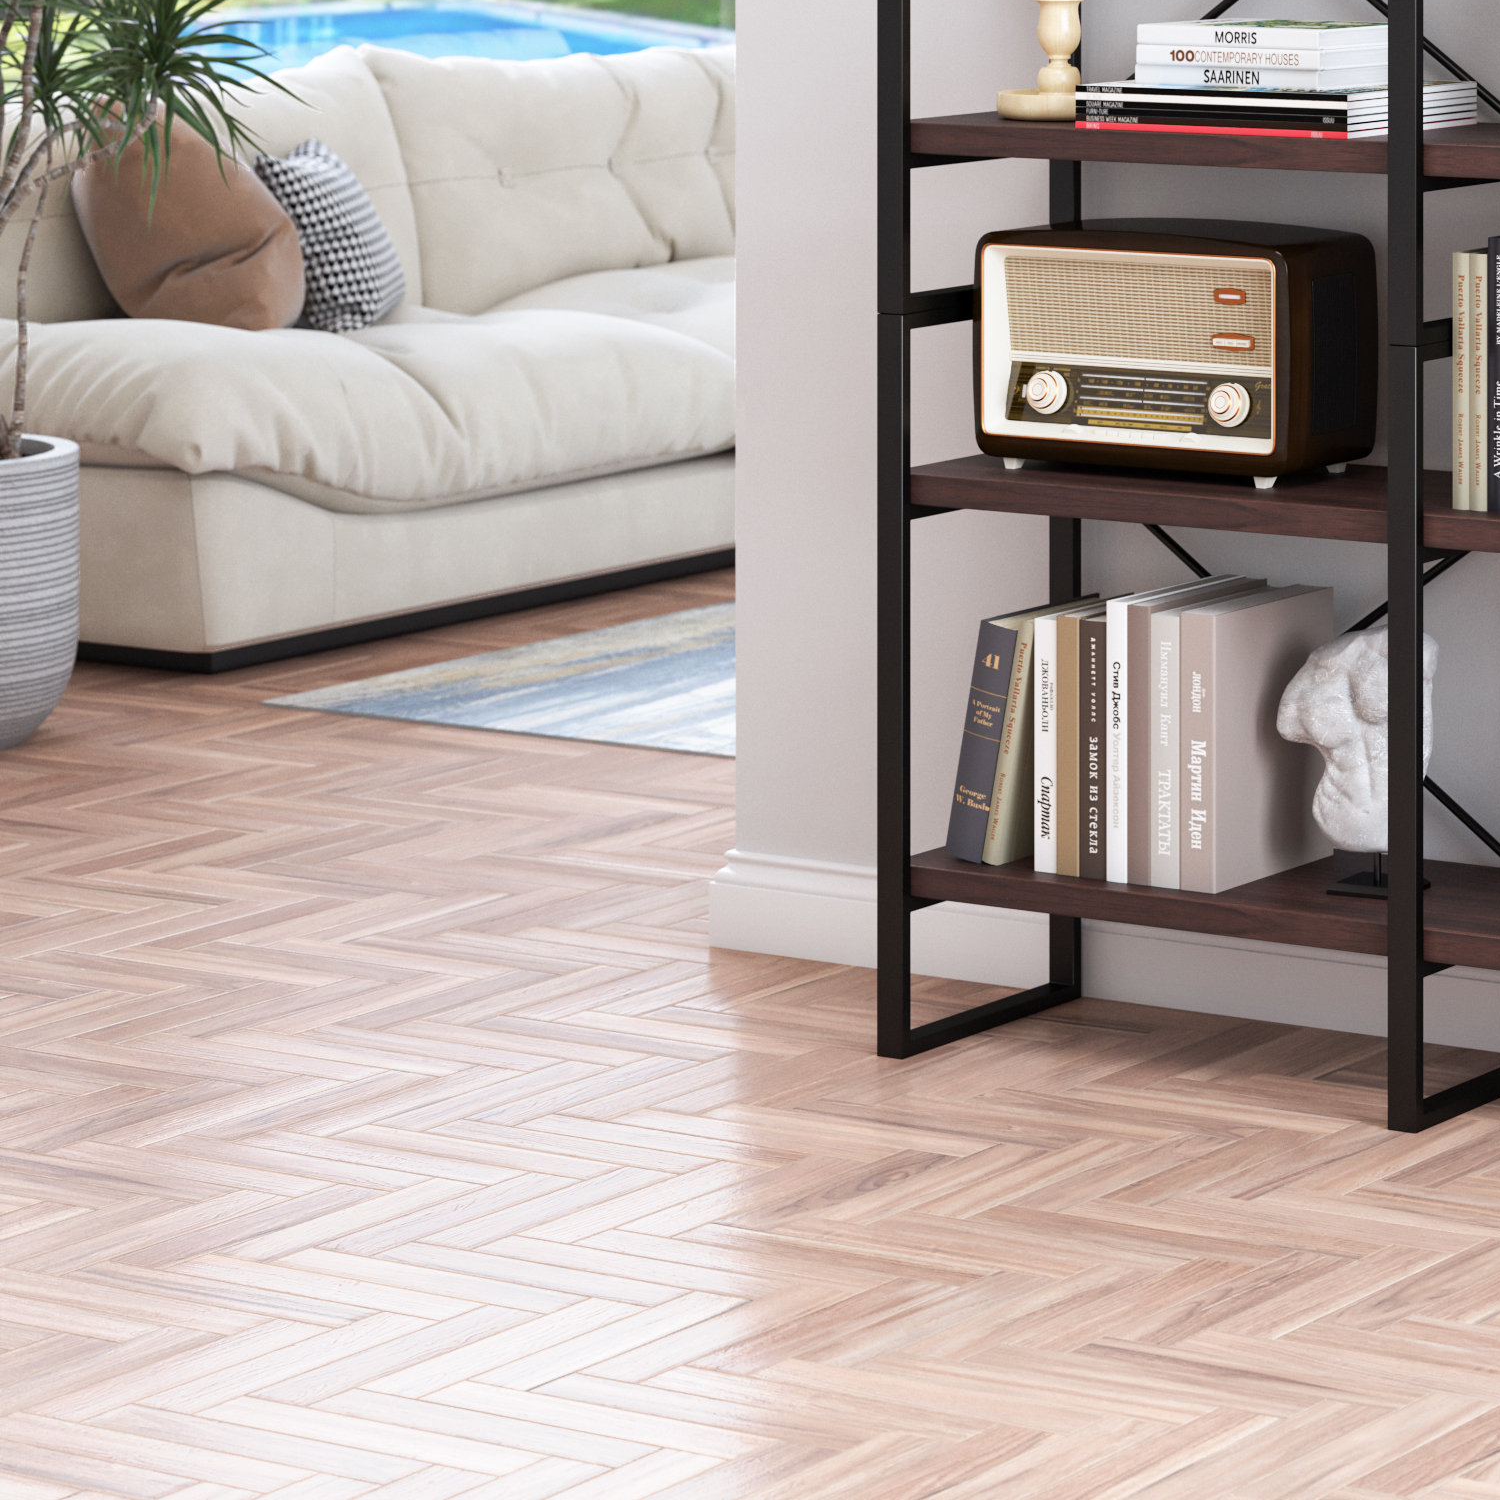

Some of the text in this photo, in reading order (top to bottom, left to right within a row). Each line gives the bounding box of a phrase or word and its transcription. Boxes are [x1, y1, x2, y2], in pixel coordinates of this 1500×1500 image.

[1214, 31, 1257, 45] MORRIS
[1265, 52, 1299, 66] HOUSES
[1203, 69, 1260, 84] SAARINEN
[1457, 275, 1466, 394] Puerto Vallarta Squeeze
[982, 653, 1000, 670] 41
[1041, 659, 1049, 732] ДЖОВАНЬОЛИ
[1111, 661, 1121, 729] Стив Джобс
[976, 699, 1001, 714] Portrait
[974, 716, 993, 727] Father
[956, 793, 967, 804] W.
[959, 785, 987, 799] George
[1088, 737, 1098, 854] замок из стекла
[1188, 739, 1207, 849] Мартин Иден
[1037, 776, 1051, 839] Спартак
[1158, 769, 1172, 856] ТРАКТАТЫ
